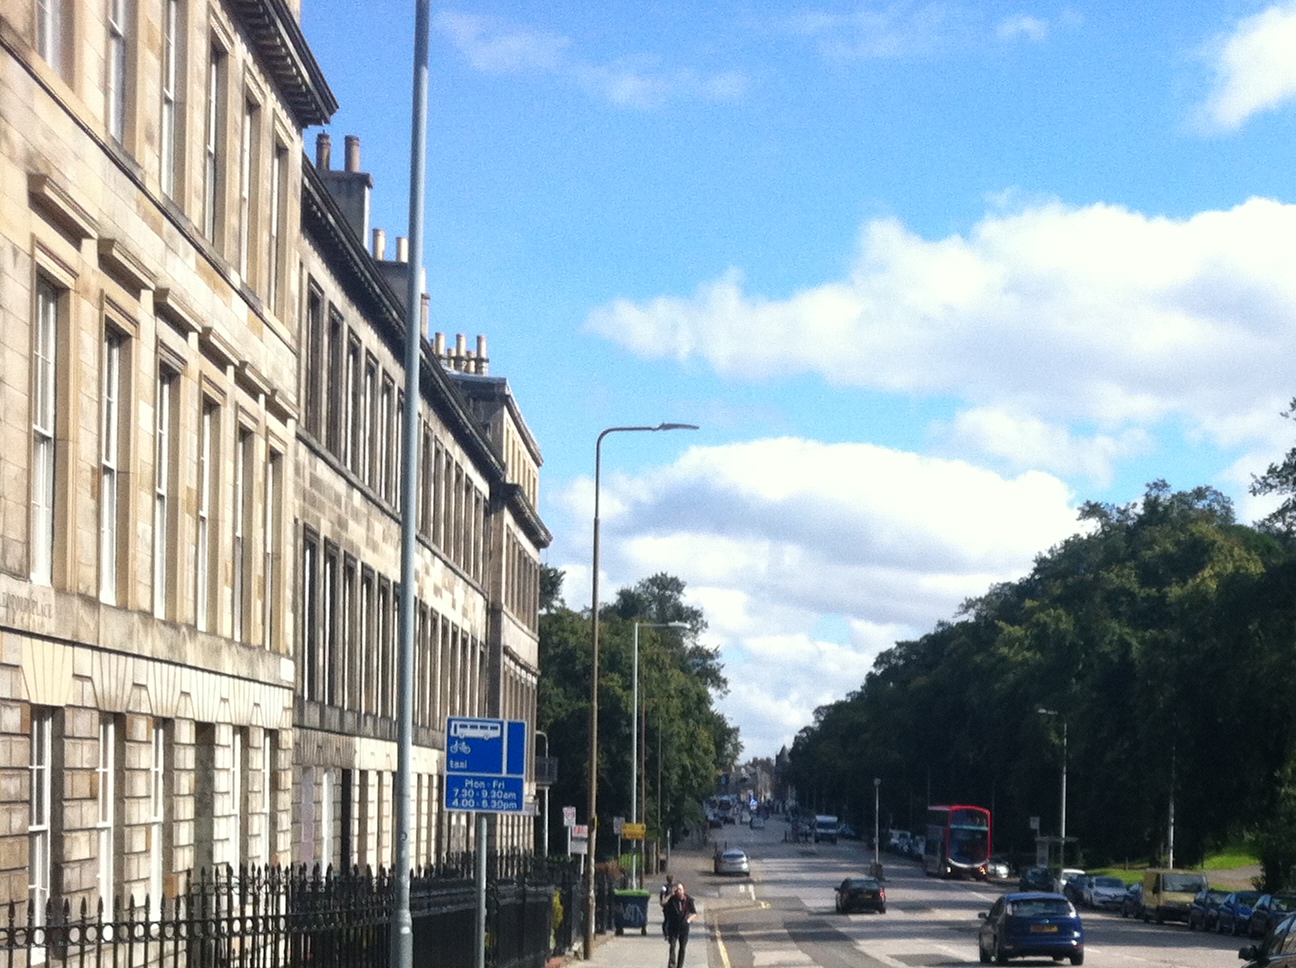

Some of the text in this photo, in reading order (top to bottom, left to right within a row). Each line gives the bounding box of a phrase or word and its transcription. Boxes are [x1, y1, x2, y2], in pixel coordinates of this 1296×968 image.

[449, 760, 468, 769] taxi
[464, 779, 486, 788] Mon
[492, 780, 505, 789] Fri
[453, 788, 474, 797] 7.30
[481, 789, 517, 799] 9.30am
[452, 798, 475, 807] 4.00
